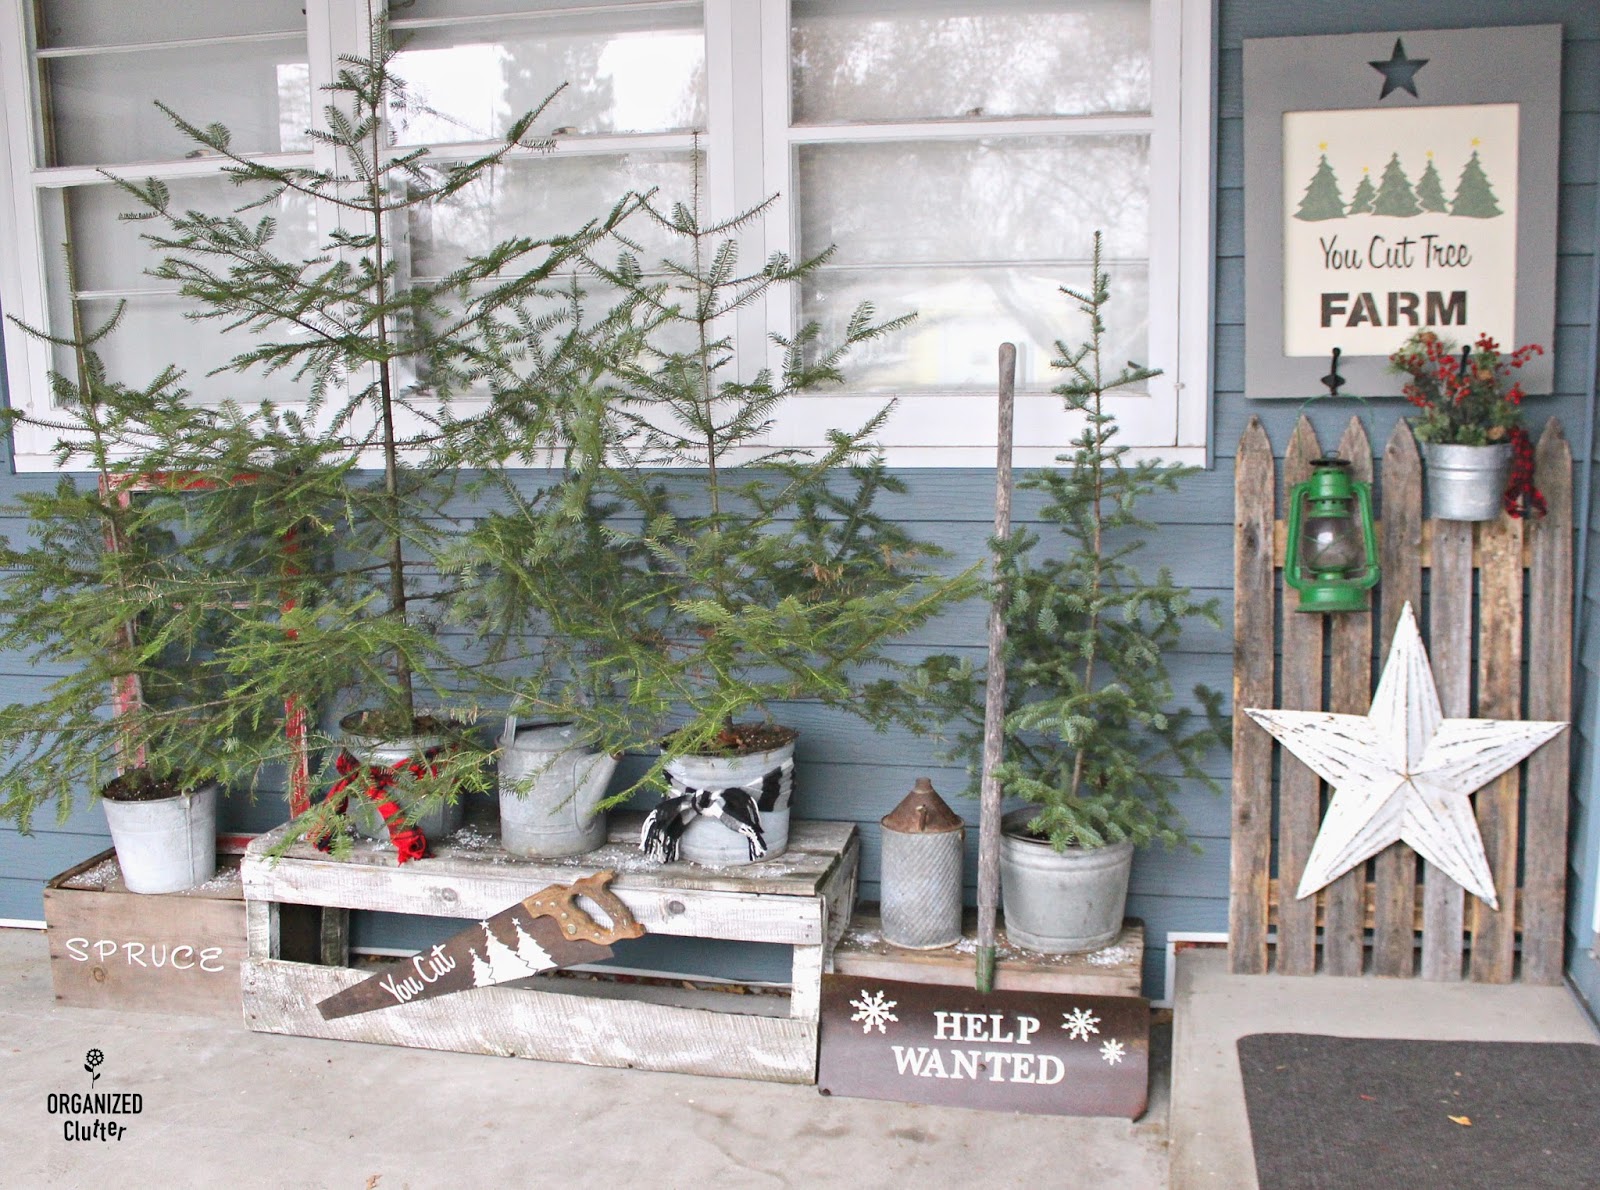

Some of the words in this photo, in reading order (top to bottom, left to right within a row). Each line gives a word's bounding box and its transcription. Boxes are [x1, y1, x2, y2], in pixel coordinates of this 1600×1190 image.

[1319, 234, 1362, 270] You
[1368, 235, 1414, 269] Cut
[1420, 234, 1472, 269] Tree
[1320, 291, 1467, 328] FARM
[65, 937, 224, 972] SPRUCE
[379, 973, 424, 1004] You
[414, 943, 456, 984] Cut
[933, 1011, 1041, 1045] HELP
[891, 1045, 1065, 1085] WANTED
